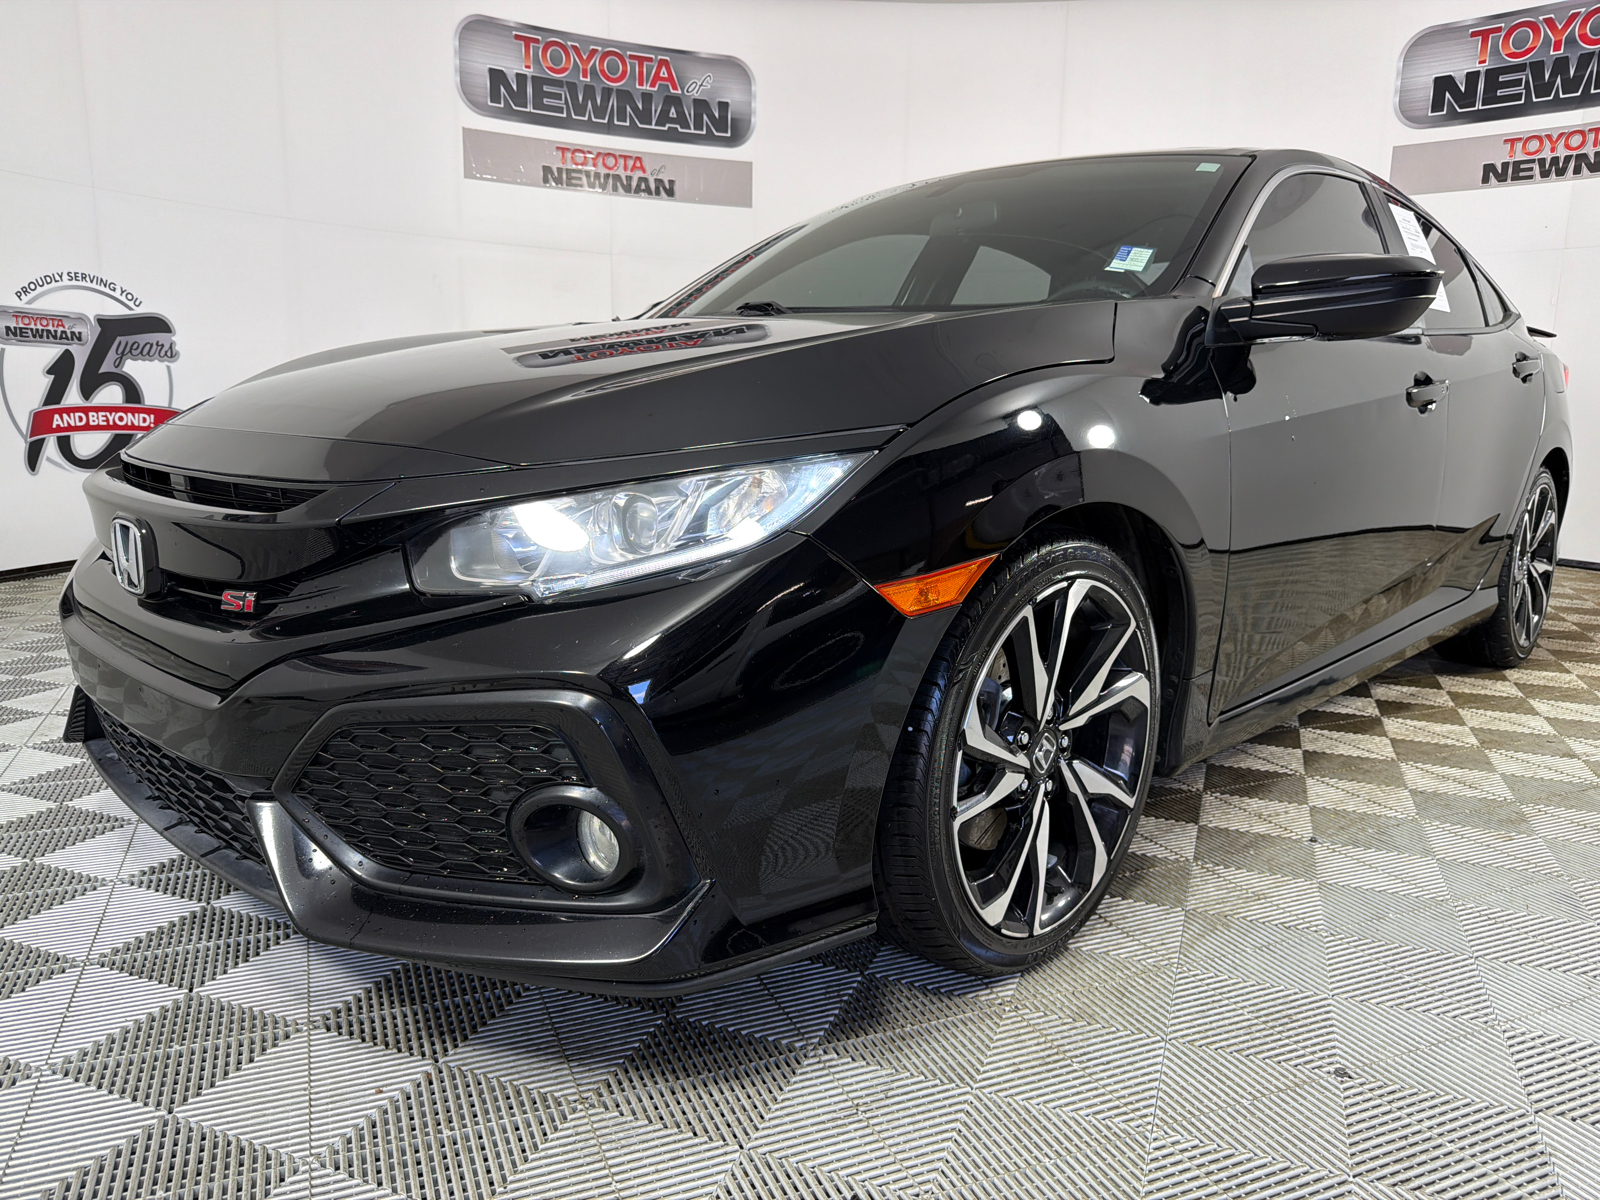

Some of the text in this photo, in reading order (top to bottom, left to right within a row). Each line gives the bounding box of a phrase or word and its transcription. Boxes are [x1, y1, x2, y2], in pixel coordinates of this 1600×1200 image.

[513, 32, 712, 95] TOYOTA of
[1428, 49, 1600, 116] NEW
[487, 65, 732, 137] NEWNAN
[555, 146, 666, 176] TOYOTA of
[541, 164, 677, 199] NEWNAN
[14, 271, 143, 308] PROUDLY SERVING YOU
[5, 326, 83, 342] NEWNAN
[12, 314, 65, 329] TOYOTA
[115, 339, 178, 369] years
[52, 411, 155, 429] AND BEYOND!
[221, 590, 257, 612] Si
